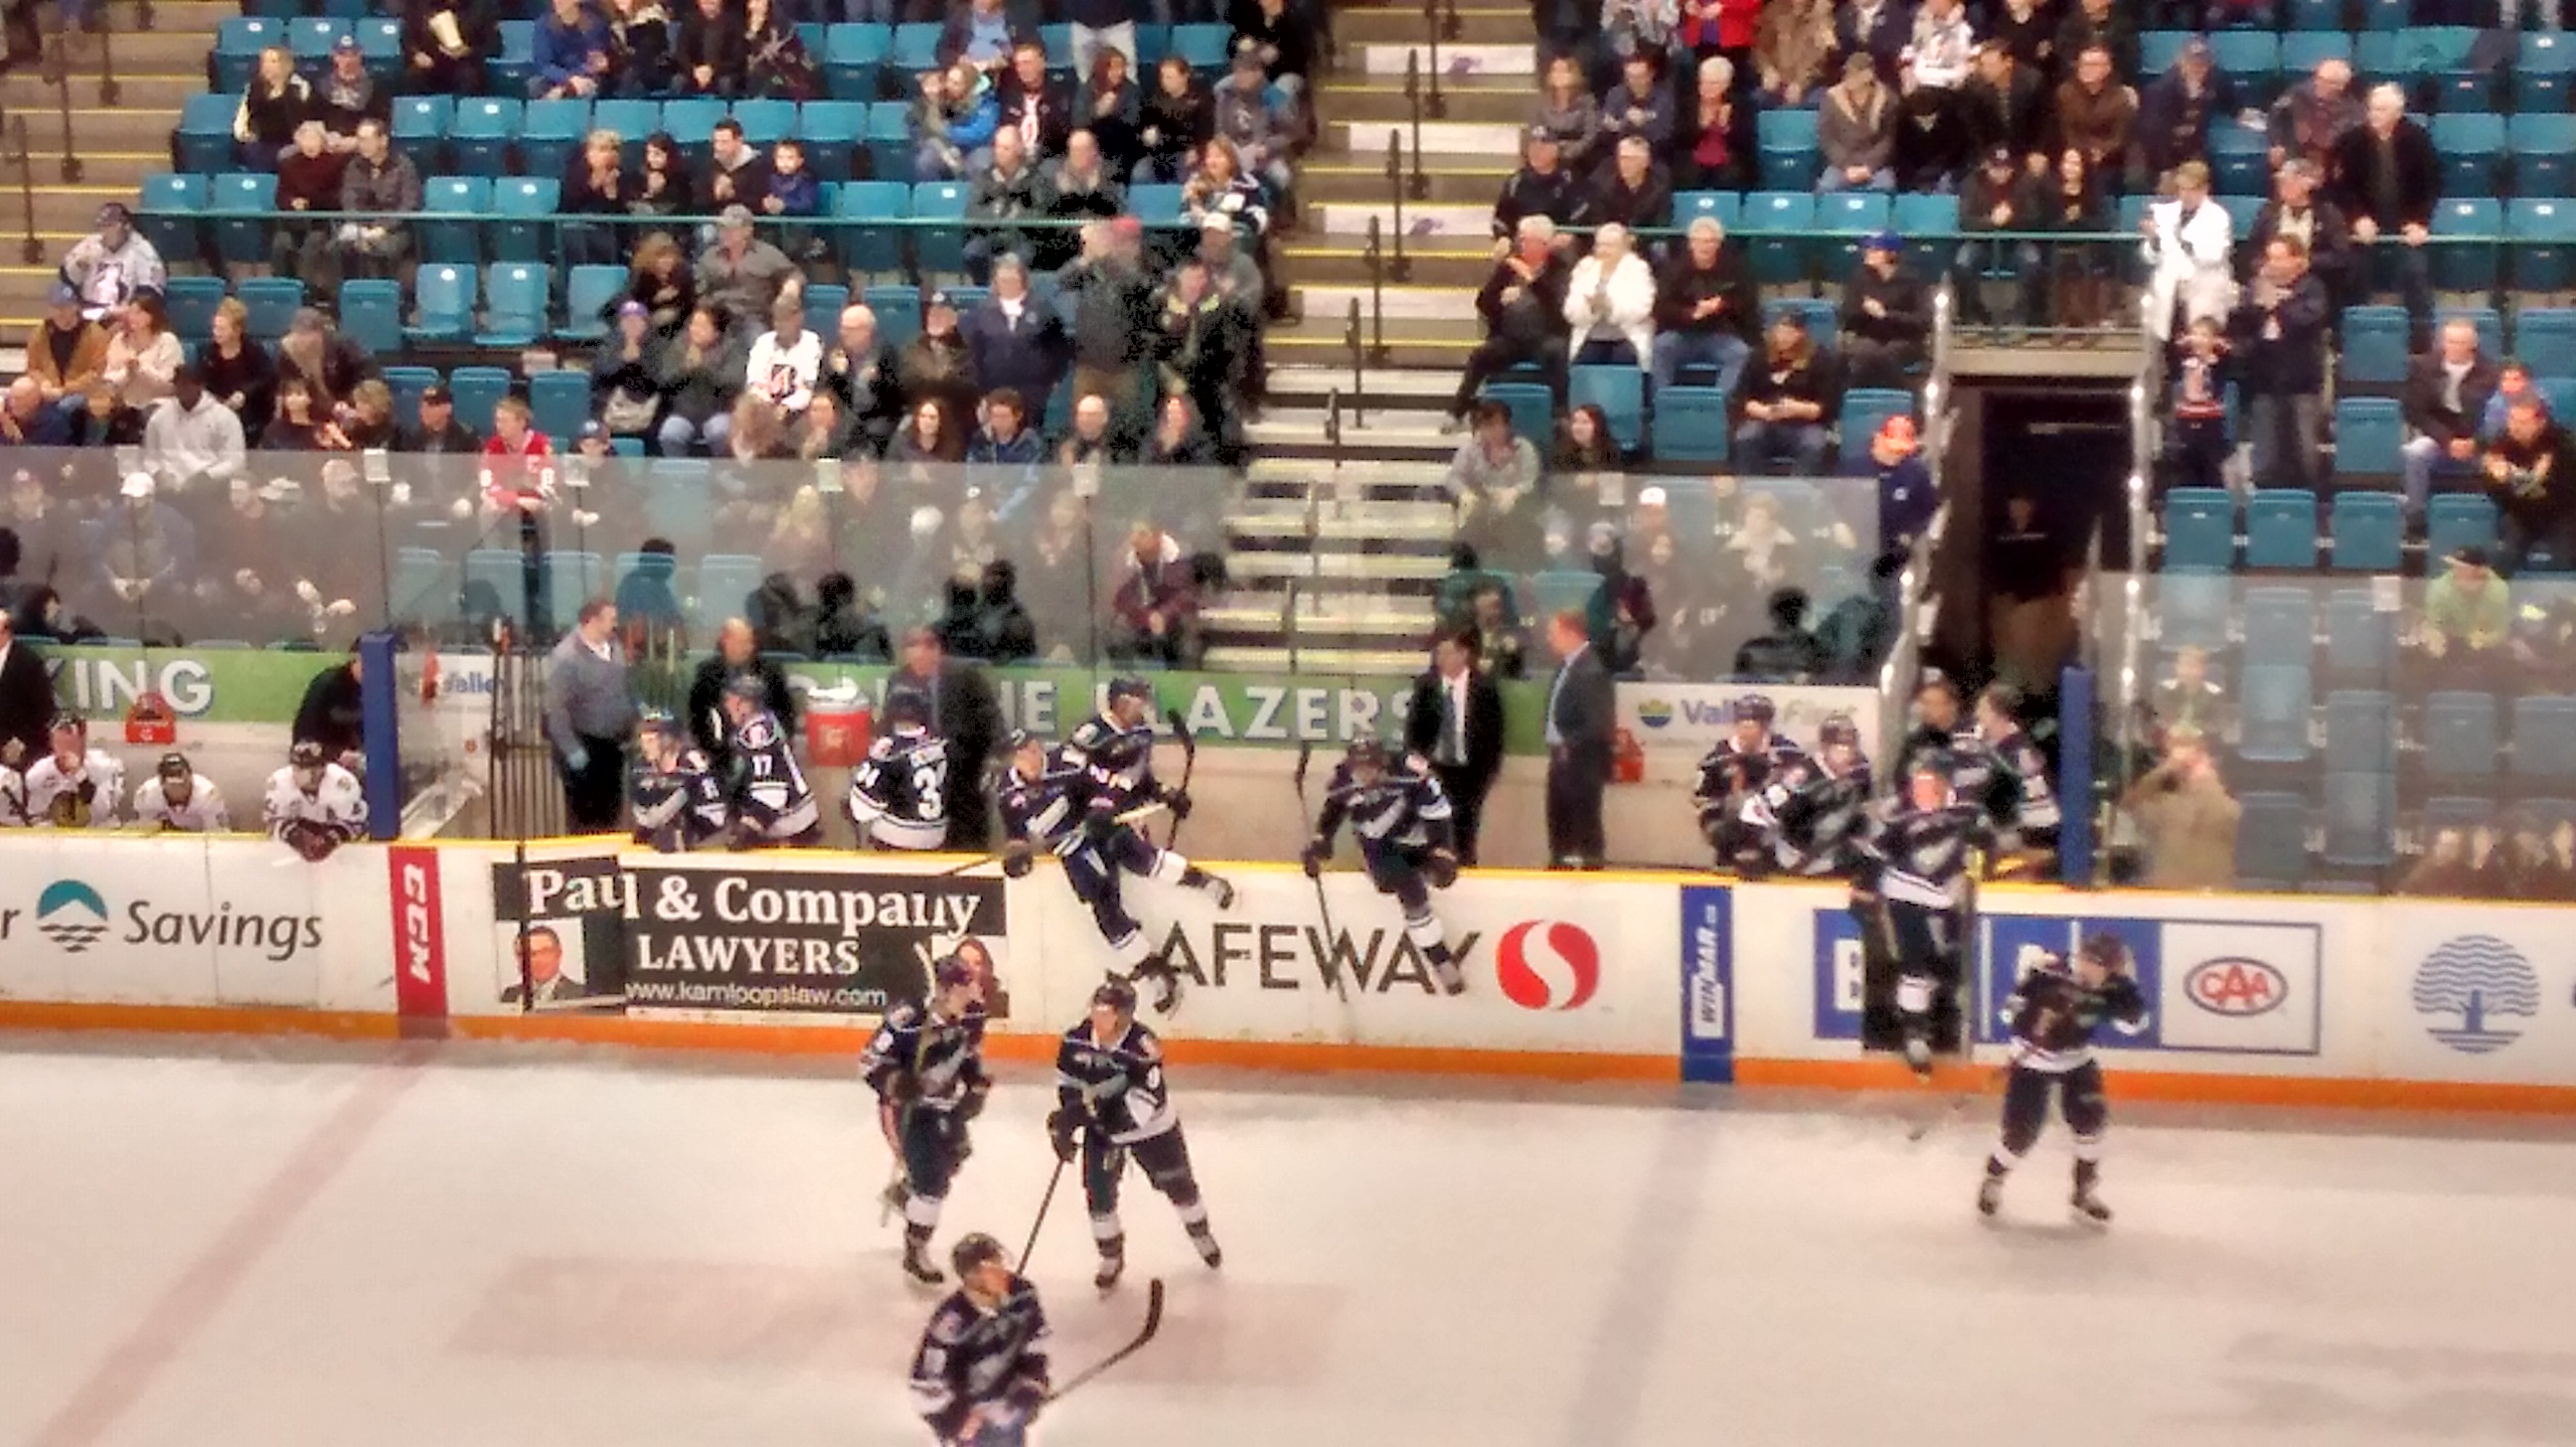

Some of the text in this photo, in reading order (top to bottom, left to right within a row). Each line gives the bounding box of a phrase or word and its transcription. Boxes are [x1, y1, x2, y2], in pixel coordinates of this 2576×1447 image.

[124, 900, 323, 962] Savings
[402, 863, 431, 984] CCM
[524, 869, 982, 939] Paul & Company
[638, 934, 861, 975] LAWYERS
[2198, 964, 2274, 1009] CAA
